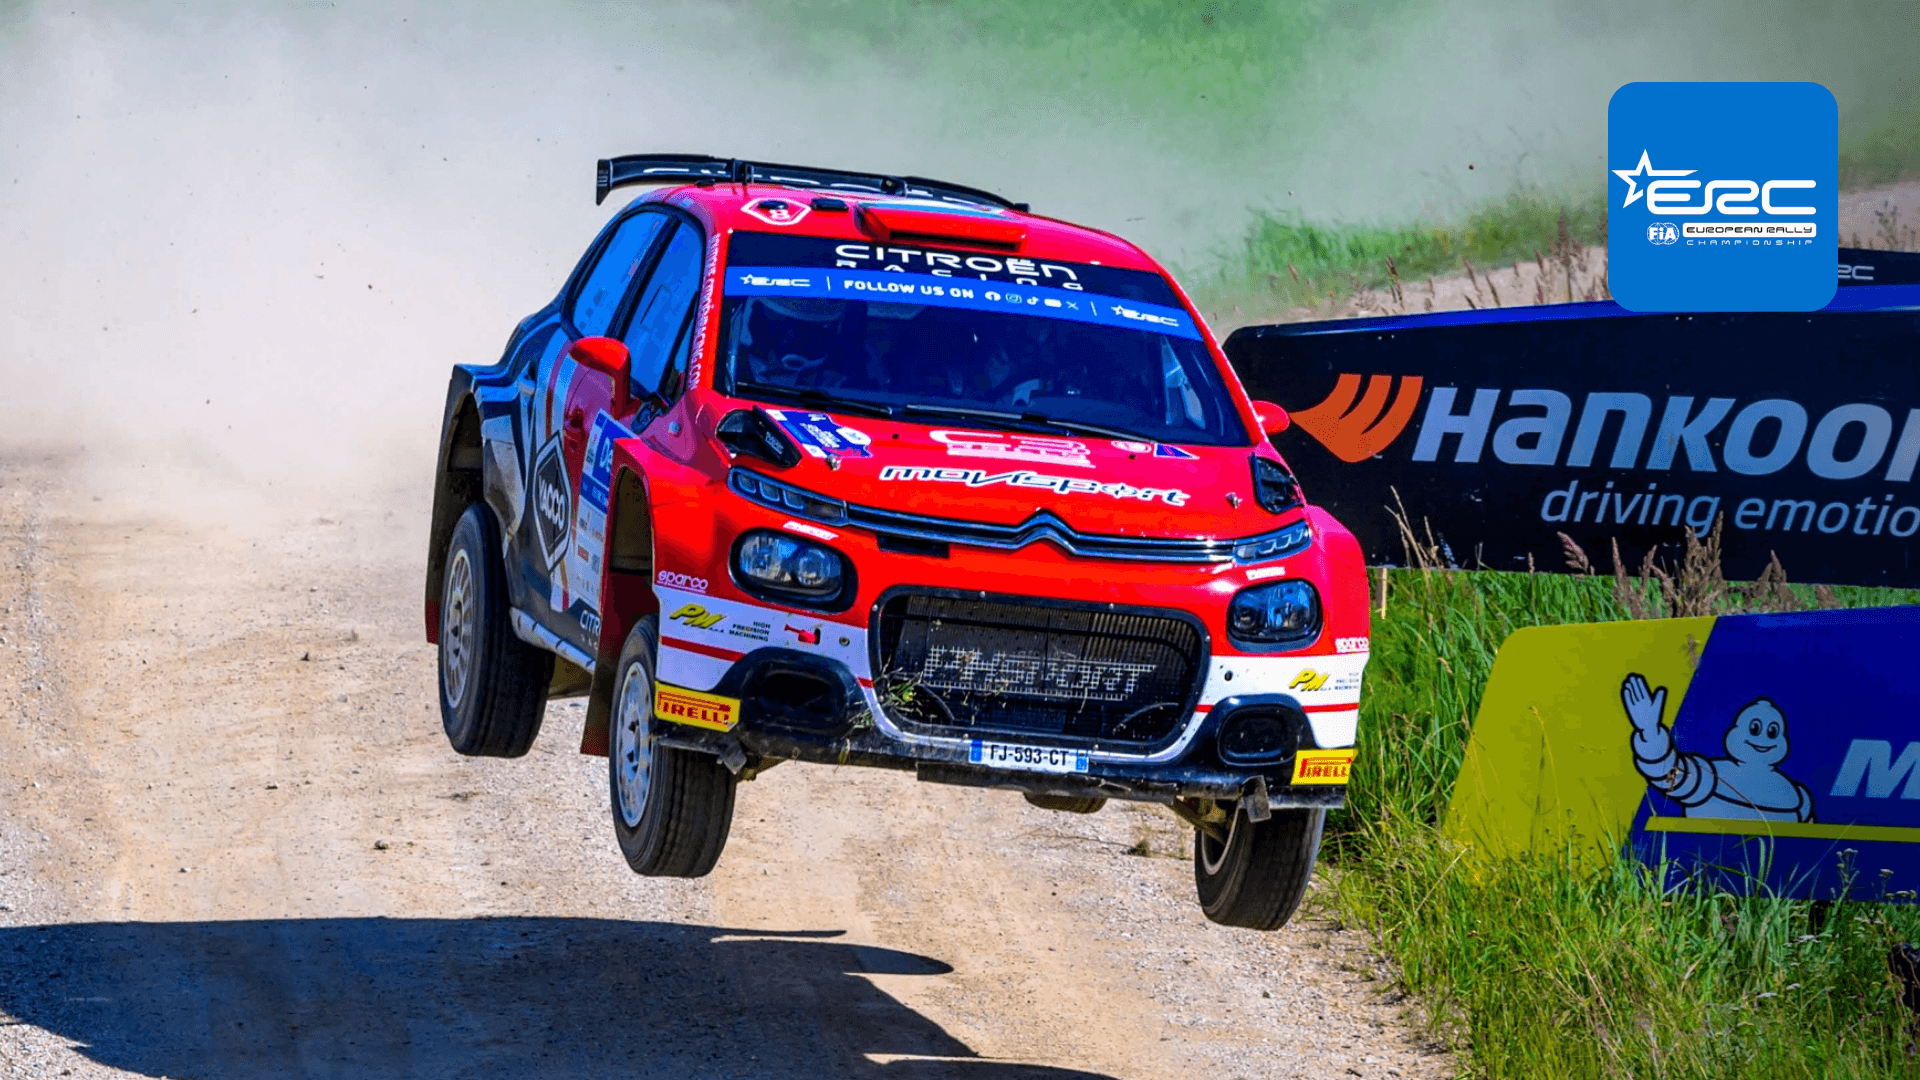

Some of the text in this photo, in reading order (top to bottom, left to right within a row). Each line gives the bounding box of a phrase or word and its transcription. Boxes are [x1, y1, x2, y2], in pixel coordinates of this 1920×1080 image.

[843, 279, 975, 299] FOLLOW US ON
[1541, 480, 1722, 538] driving
[656, 569, 709, 591] sparco
[732, 623, 770, 636] PRECISION
[753, 620, 771, 630] HIGH
[728, 629, 769, 642] MACHINING
[656, 689, 732, 726] PIRELLI
[990, 745, 1069, 766] FJ-593-CT
